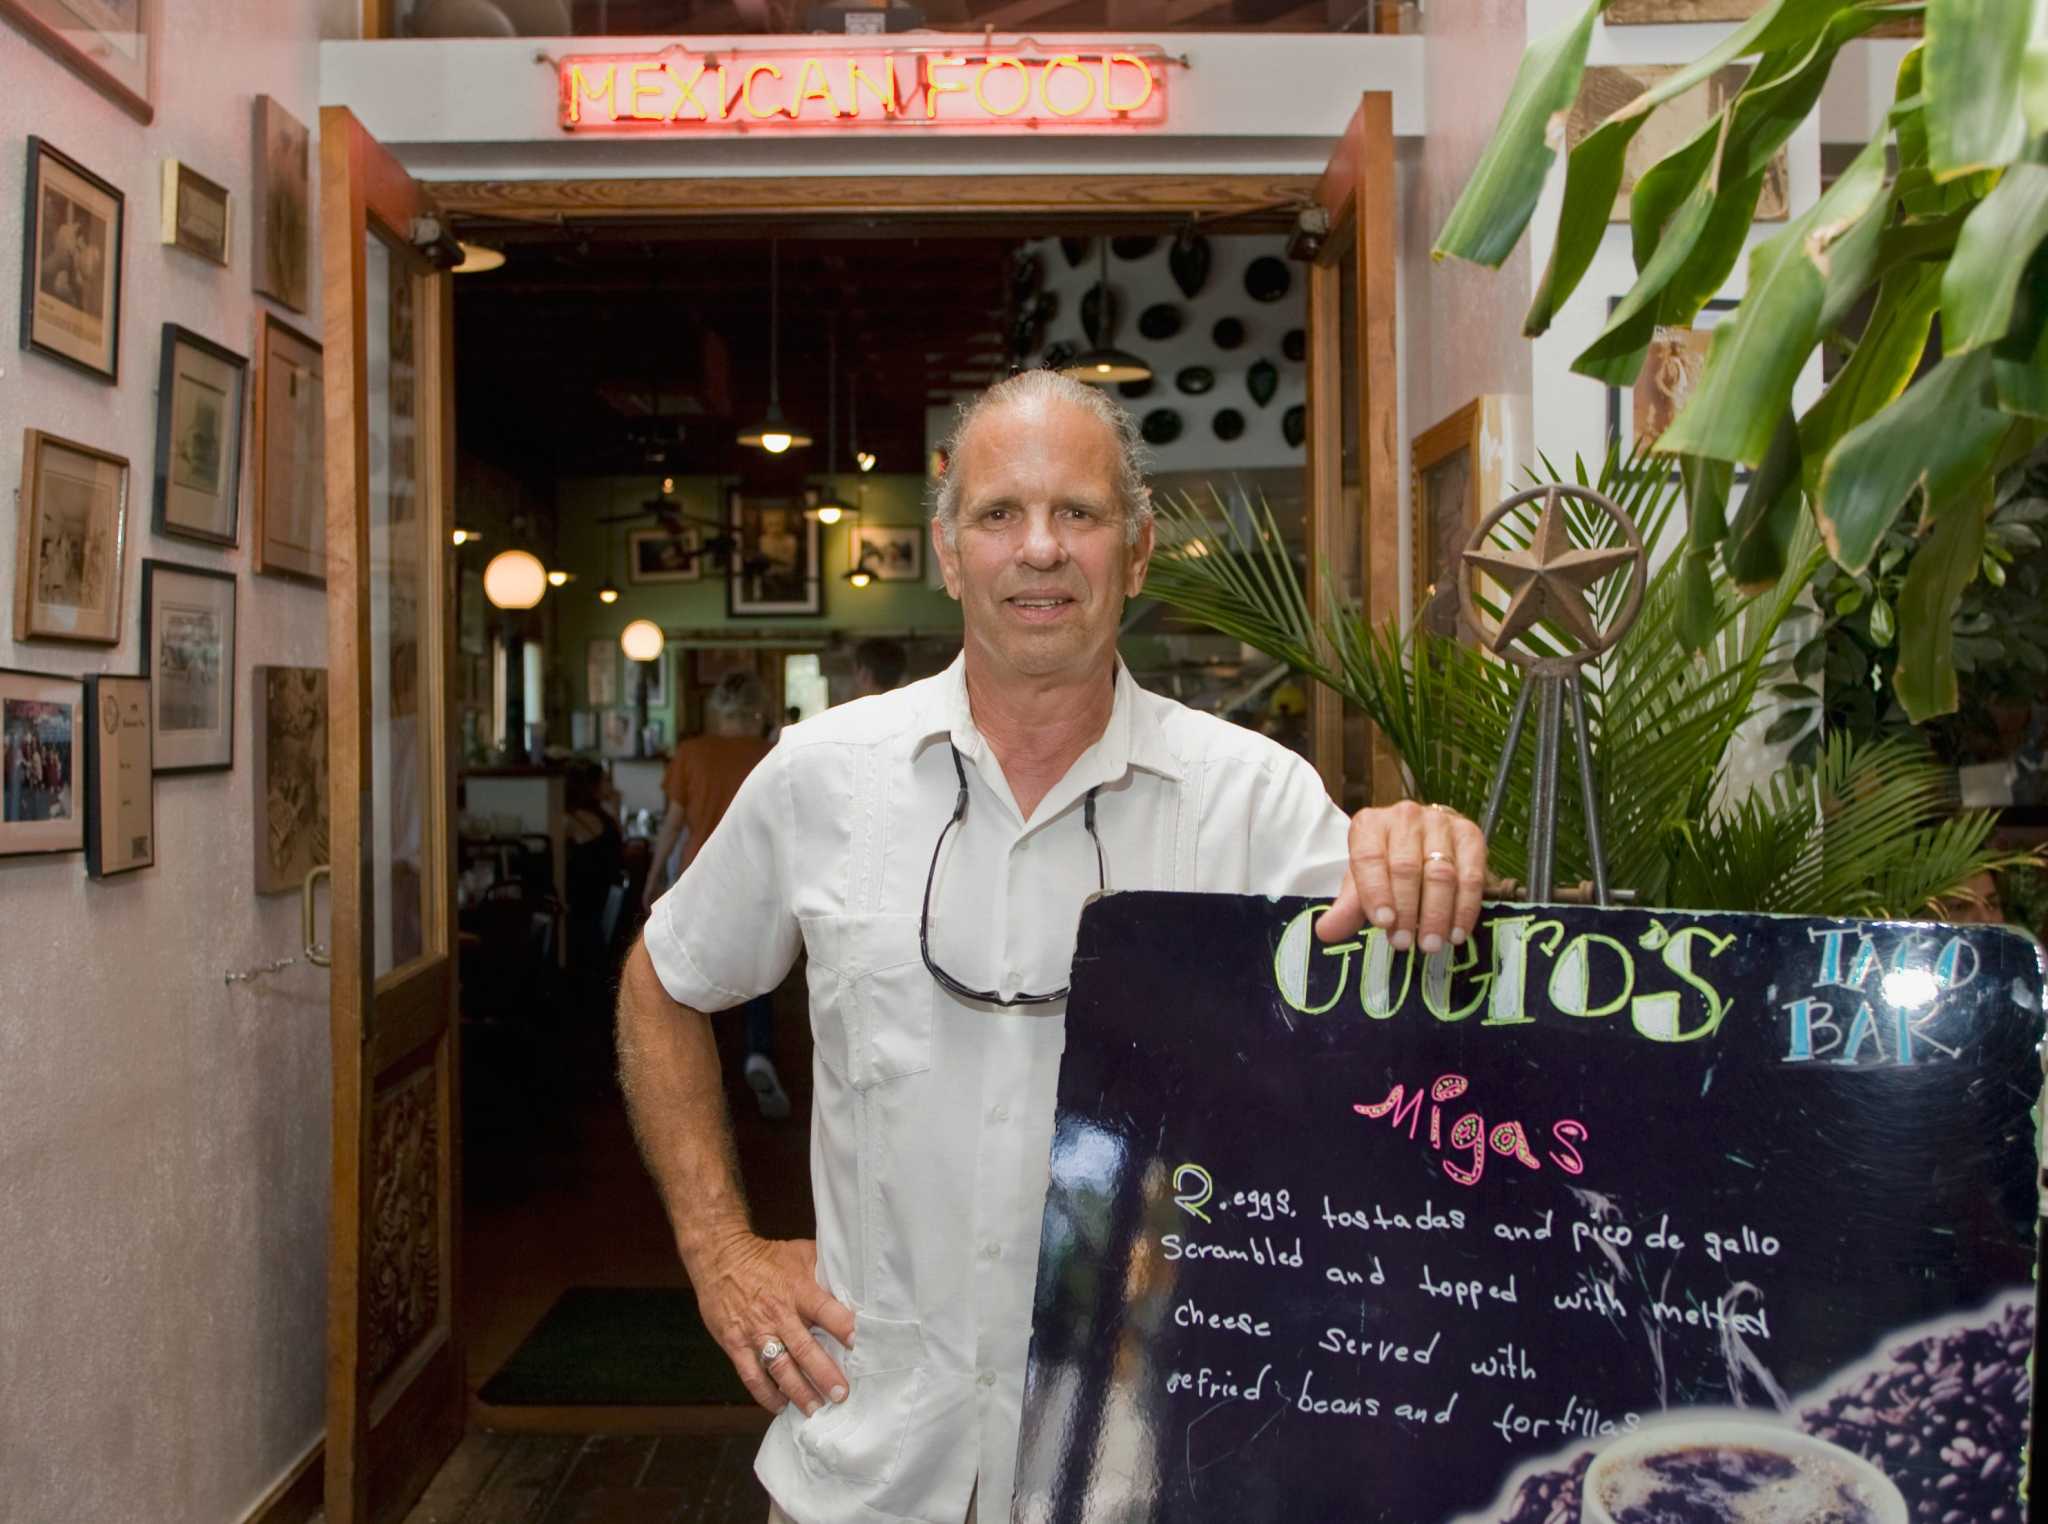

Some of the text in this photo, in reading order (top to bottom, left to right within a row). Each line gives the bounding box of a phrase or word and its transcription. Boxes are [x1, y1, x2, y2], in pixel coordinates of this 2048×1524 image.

[568, 53, 1153, 121] MEXICAN FOOD
[1781, 995, 1961, 1066] BAR
[1353, 1074, 1588, 1186] Migas
[1322, 1195, 1465, 1231] tostadas
[1494, 1209, 1553, 1242] and
[1572, 1211, 1633, 1252] pico
[1645, 1213, 1686, 1249] de
[1704, 1224, 1780, 1262] gallo
[1160, 1234, 1304, 1268] Scrambled
[1326, 1256, 1386, 1286] and
[1418, 1265, 1518, 1310] topped
[1553, 1282, 1627, 1318] with
[1470, 1342, 1537, 1380] with
[1297, 1370, 1381, 1416] beans
[1395, 1392, 1459, 1426] and
[1493, 1395, 1642, 1442] tortillas
